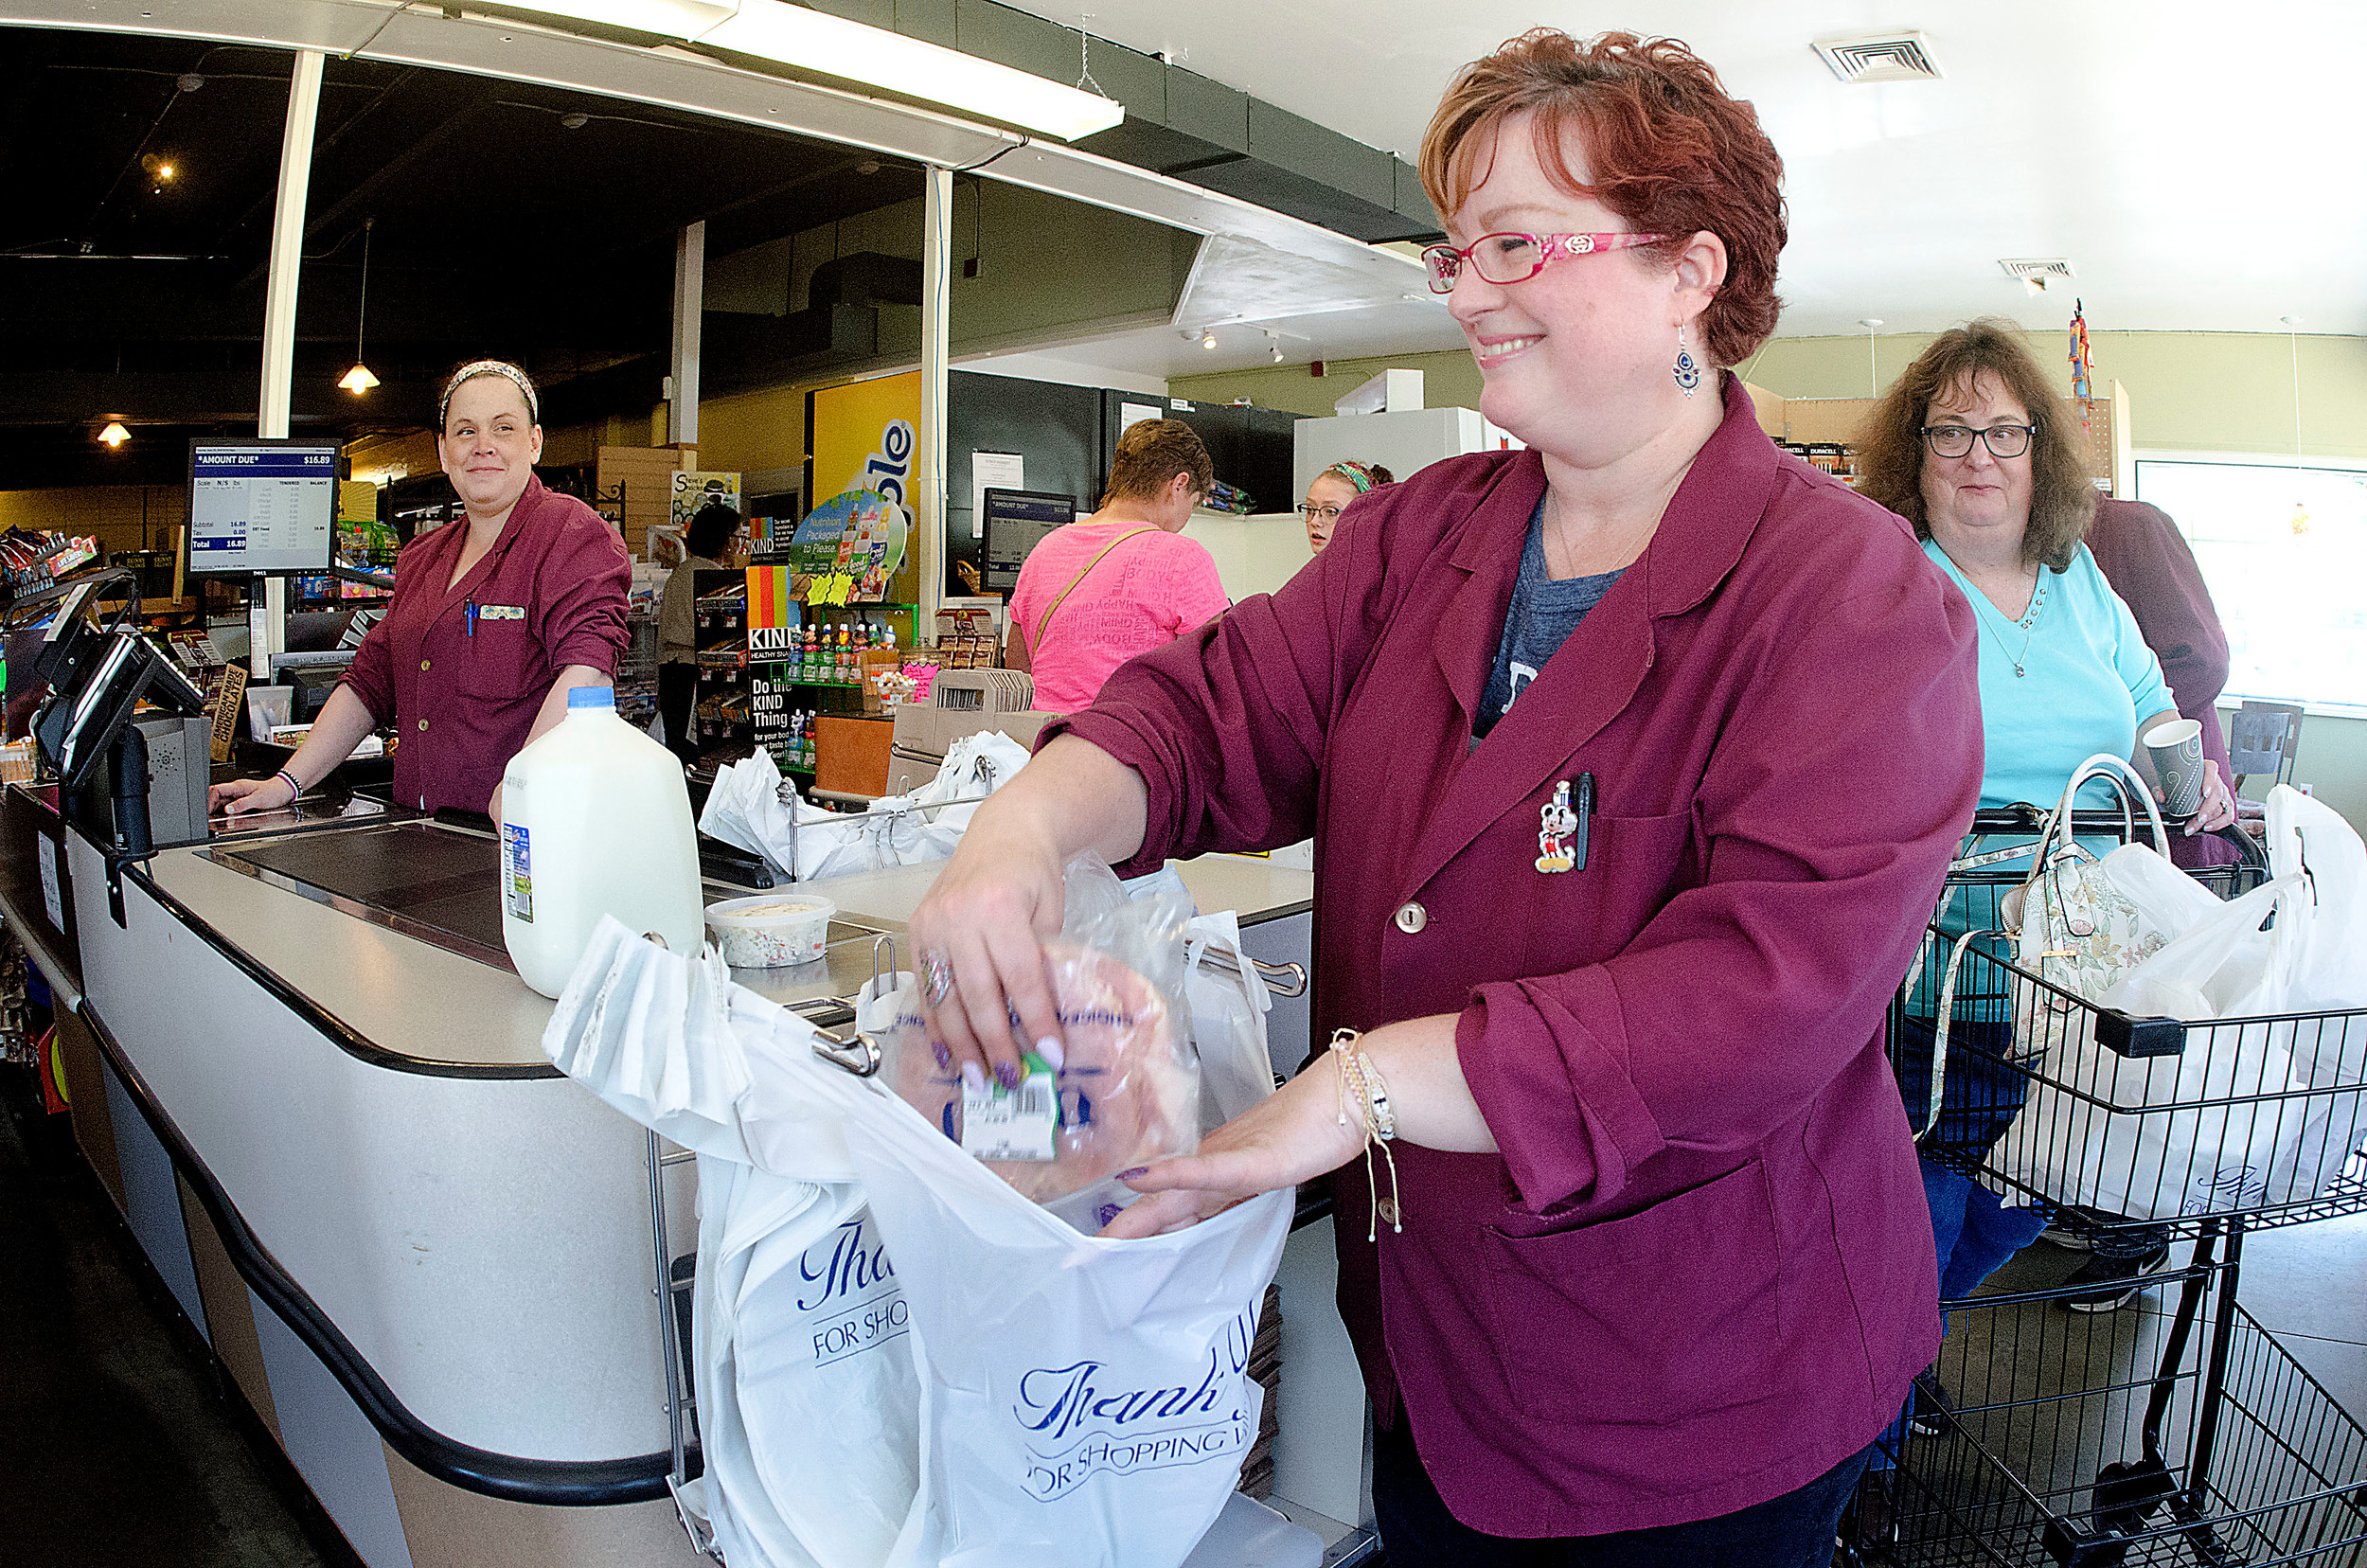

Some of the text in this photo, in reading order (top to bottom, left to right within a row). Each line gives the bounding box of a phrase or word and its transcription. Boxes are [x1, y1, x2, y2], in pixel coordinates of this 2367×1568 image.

[304, 456, 330, 464] $16.89
[806, 531, 840, 541] Packaged
[751, 538, 774, 554] KIND
[803, 544, 812, 553] to
[1094, 633, 1131, 644] BODY
[753, 679, 769, 694] Do
[213, 668, 237, 740] AMERICAN MADE
[219, 671, 244, 743] CHOCOLATES
[753, 694, 783, 711] KIND
[753, 711, 787, 728] Thing
[764, 733, 777, 741] your
[797, 1216, 895, 1311] Tha
[813, 1300, 908, 1359] FOR SHO
[1013, 1346, 1228, 1440] Thank
[1078, 1431, 1227, 1475] SHOPPING
